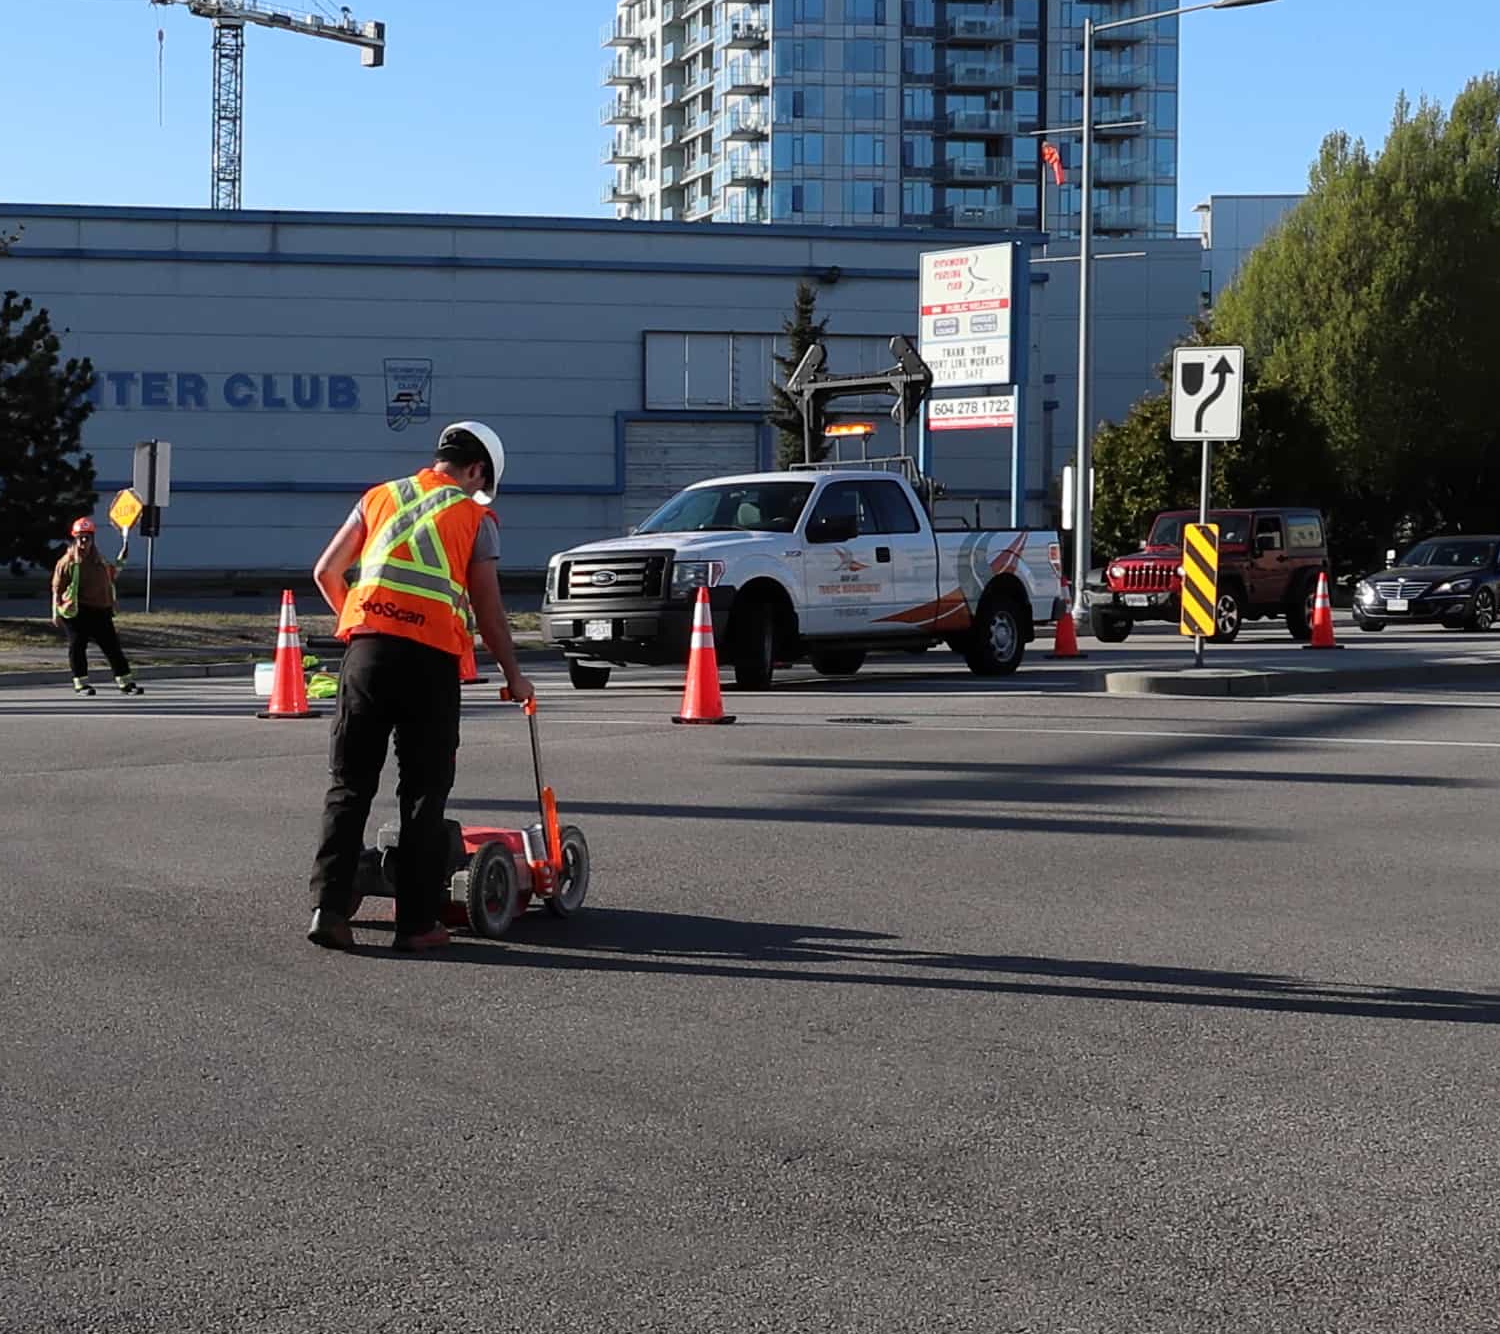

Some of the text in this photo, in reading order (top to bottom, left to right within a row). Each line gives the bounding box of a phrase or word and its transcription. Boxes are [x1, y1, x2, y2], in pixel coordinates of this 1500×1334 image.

[942, 346, 987, 357] THANK YOU
[951, 358, 967, 368] LINE
[970, 355, 1004, 367] WORKERS
[938, 369, 984, 380] STAY SAFE
[222, 372, 361, 411] CLUB
[934, 400, 1010, 415] 604 278 1722
